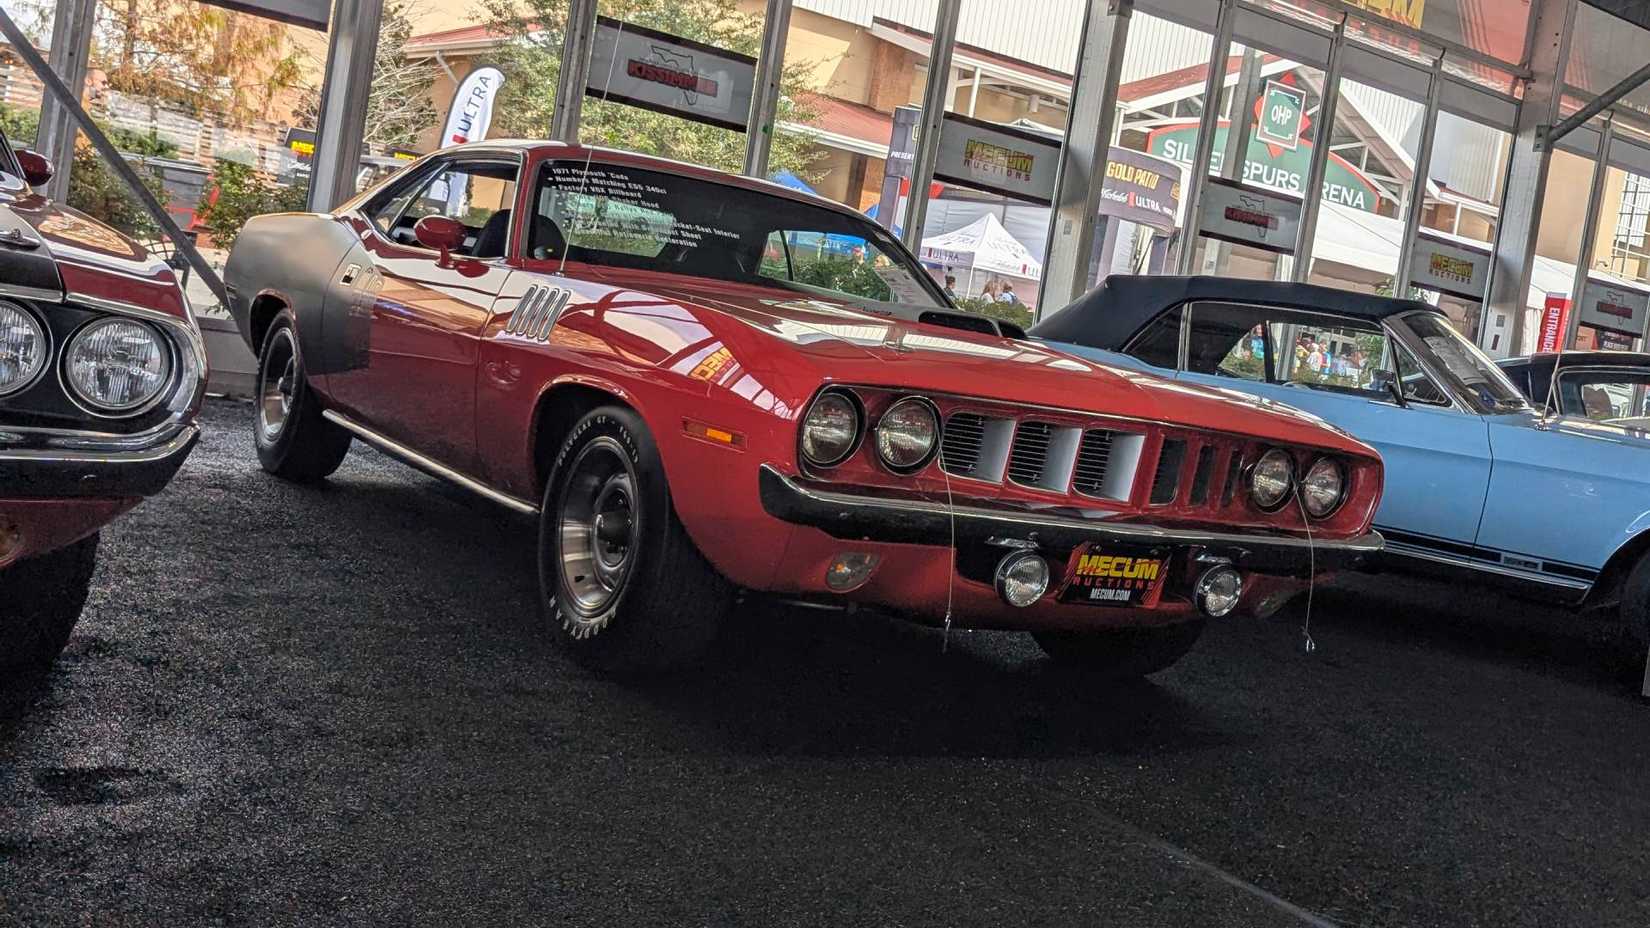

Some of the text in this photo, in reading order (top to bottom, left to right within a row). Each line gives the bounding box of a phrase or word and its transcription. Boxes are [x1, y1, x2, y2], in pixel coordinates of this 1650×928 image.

[458, 76, 491, 132] ULTRA
[1272, 105, 1292, 126] OHP
[965, 139, 1034, 173] MECUM
[592, 178, 627, 188] Matching
[1106, 161, 1160, 190] GOLD PATIO
[1163, 138, 1366, 210] SILE SPURS RENA
[608, 188, 642, 198] Billboard
[1076, 554, 1160, 580] MECUM
[1072, 576, 1155, 590] AUCTIONS
[1090, 588, 1131, 601] MECUM.COM
